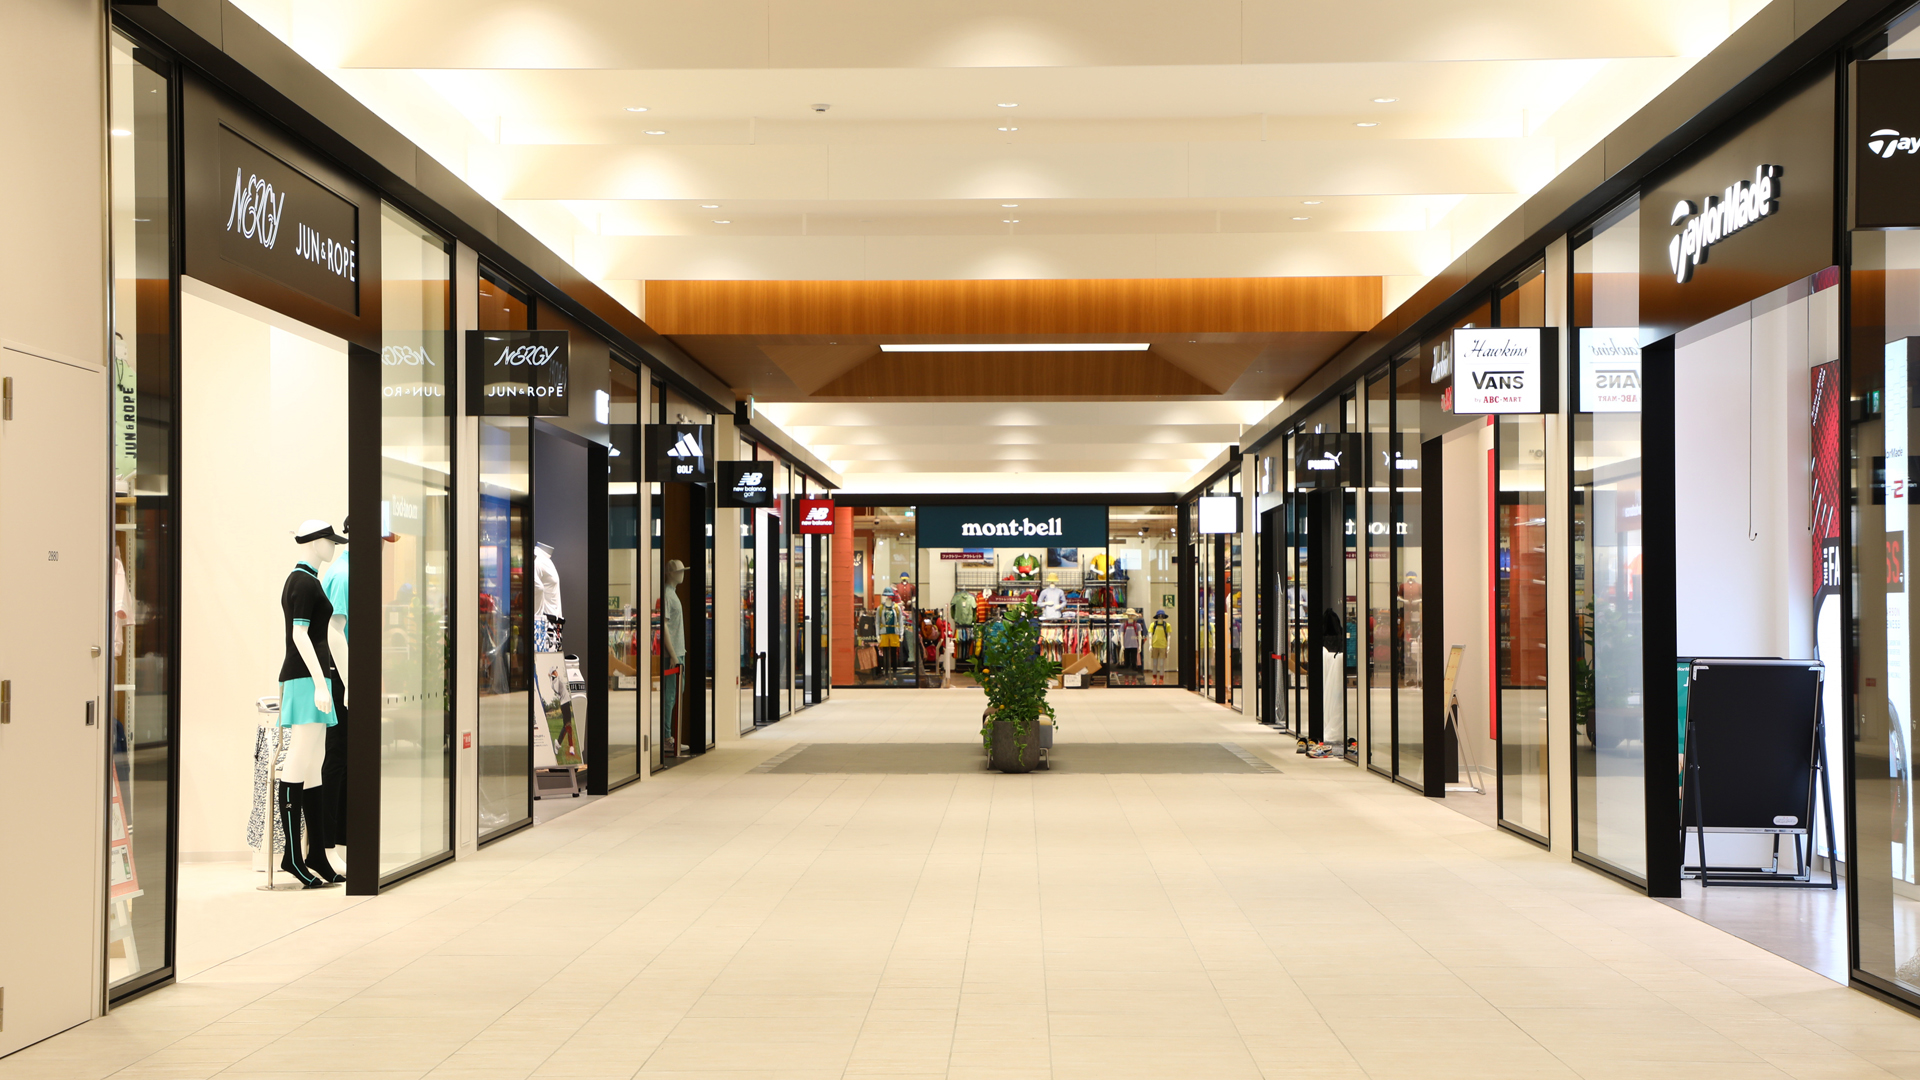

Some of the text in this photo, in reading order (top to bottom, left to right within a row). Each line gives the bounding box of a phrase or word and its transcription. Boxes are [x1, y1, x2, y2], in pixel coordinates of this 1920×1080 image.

[227, 167, 285, 250] NERGY
[1669, 164, 1775, 284] TaylorMade
[493, 345, 559, 366] NERGY
[1463, 339, 1528, 358] Hawkins
[1472, 371, 1525, 390] VANS
[1483, 395, 1522, 404] ABC-MART
[676, 465, 694, 474] GOLF
